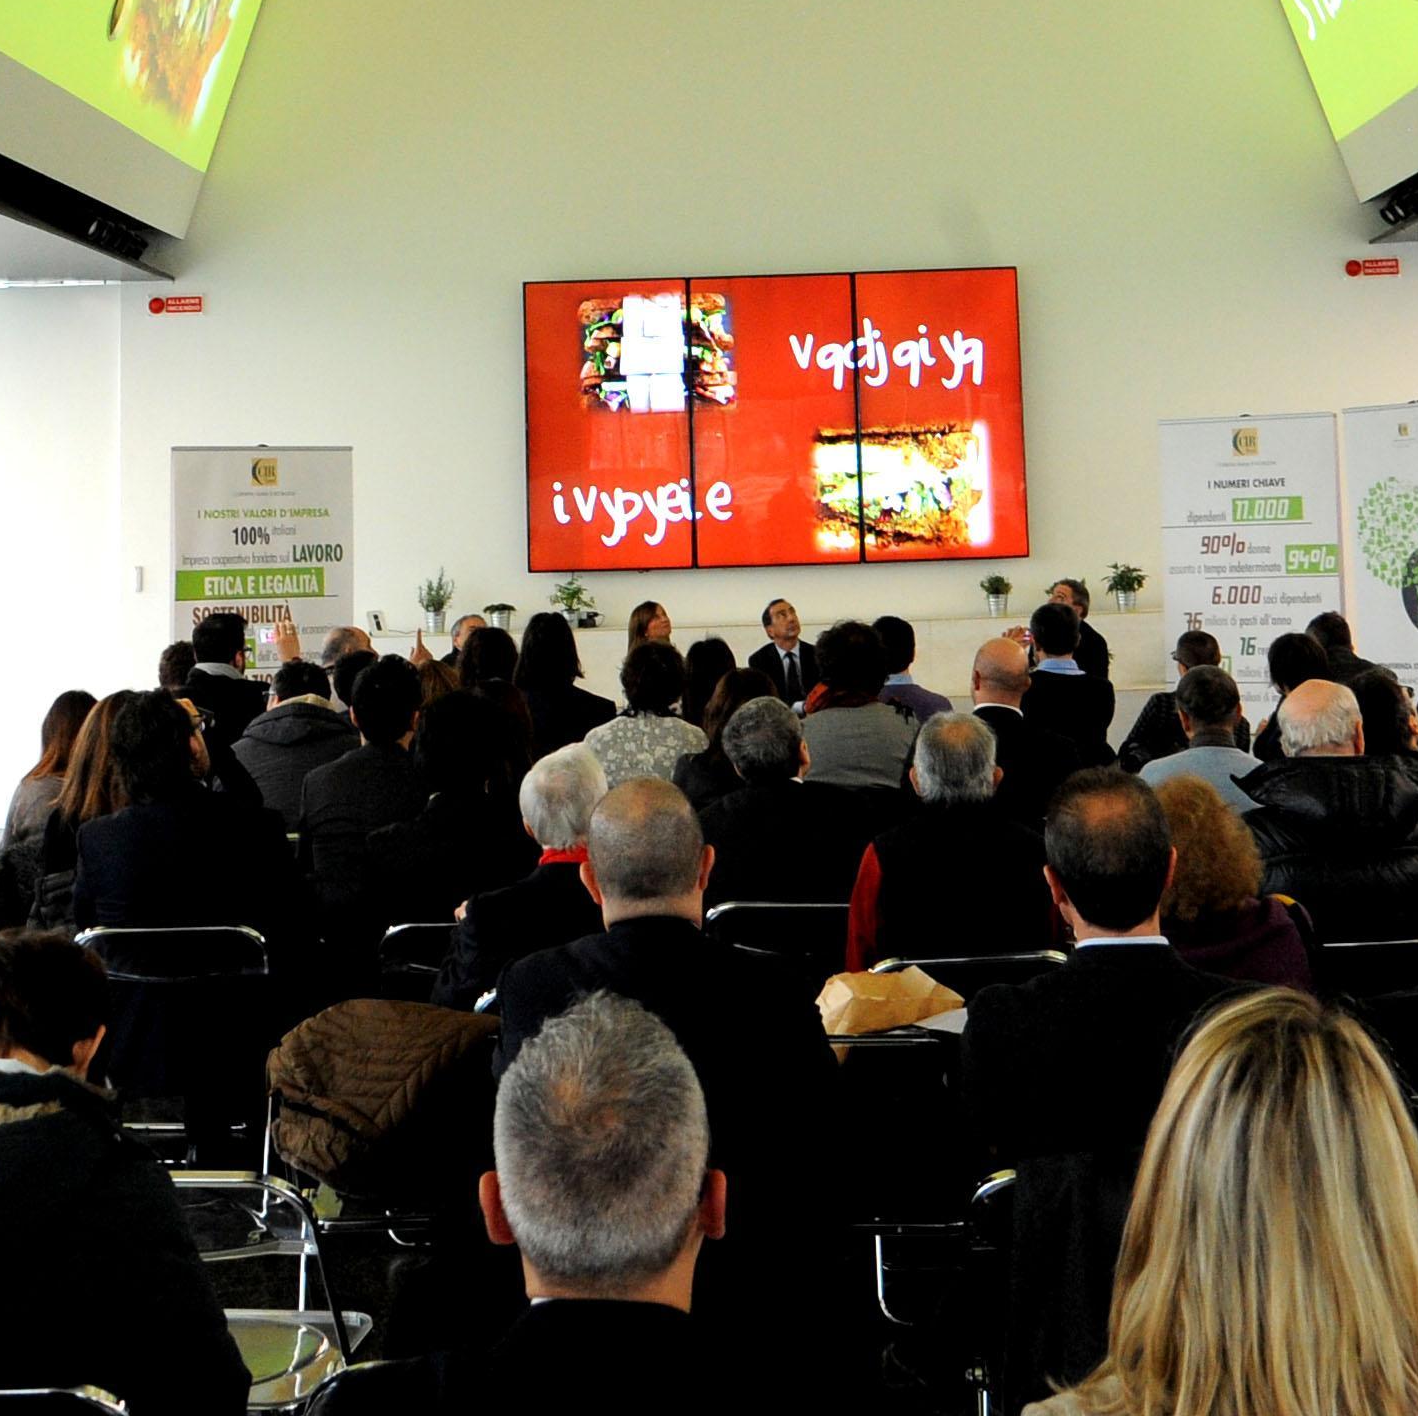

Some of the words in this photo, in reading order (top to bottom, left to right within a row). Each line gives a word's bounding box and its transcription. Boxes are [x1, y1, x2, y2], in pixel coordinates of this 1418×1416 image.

[1214, 479, 1250, 489] NUMERI
[1253, 477, 1286, 488] CHIAVE
[204, 509, 240, 520] NOSTRI
[243, 509, 277, 519] VALORI
[1235, 498, 1290, 521] 11.000
[232, 527, 270, 546] 100%
[1200, 532, 1246, 556] 90%
[293, 544, 343, 563] LAVORO
[1288, 546, 1335, 572] 94%
[204, 575, 243, 596] ETICA
[247, 577, 256, 595] E
[259, 569, 319, 594] LEGALITÀ
[1212, 585, 1262, 605] 6.000
[1239, 637, 1257, 656] 16
